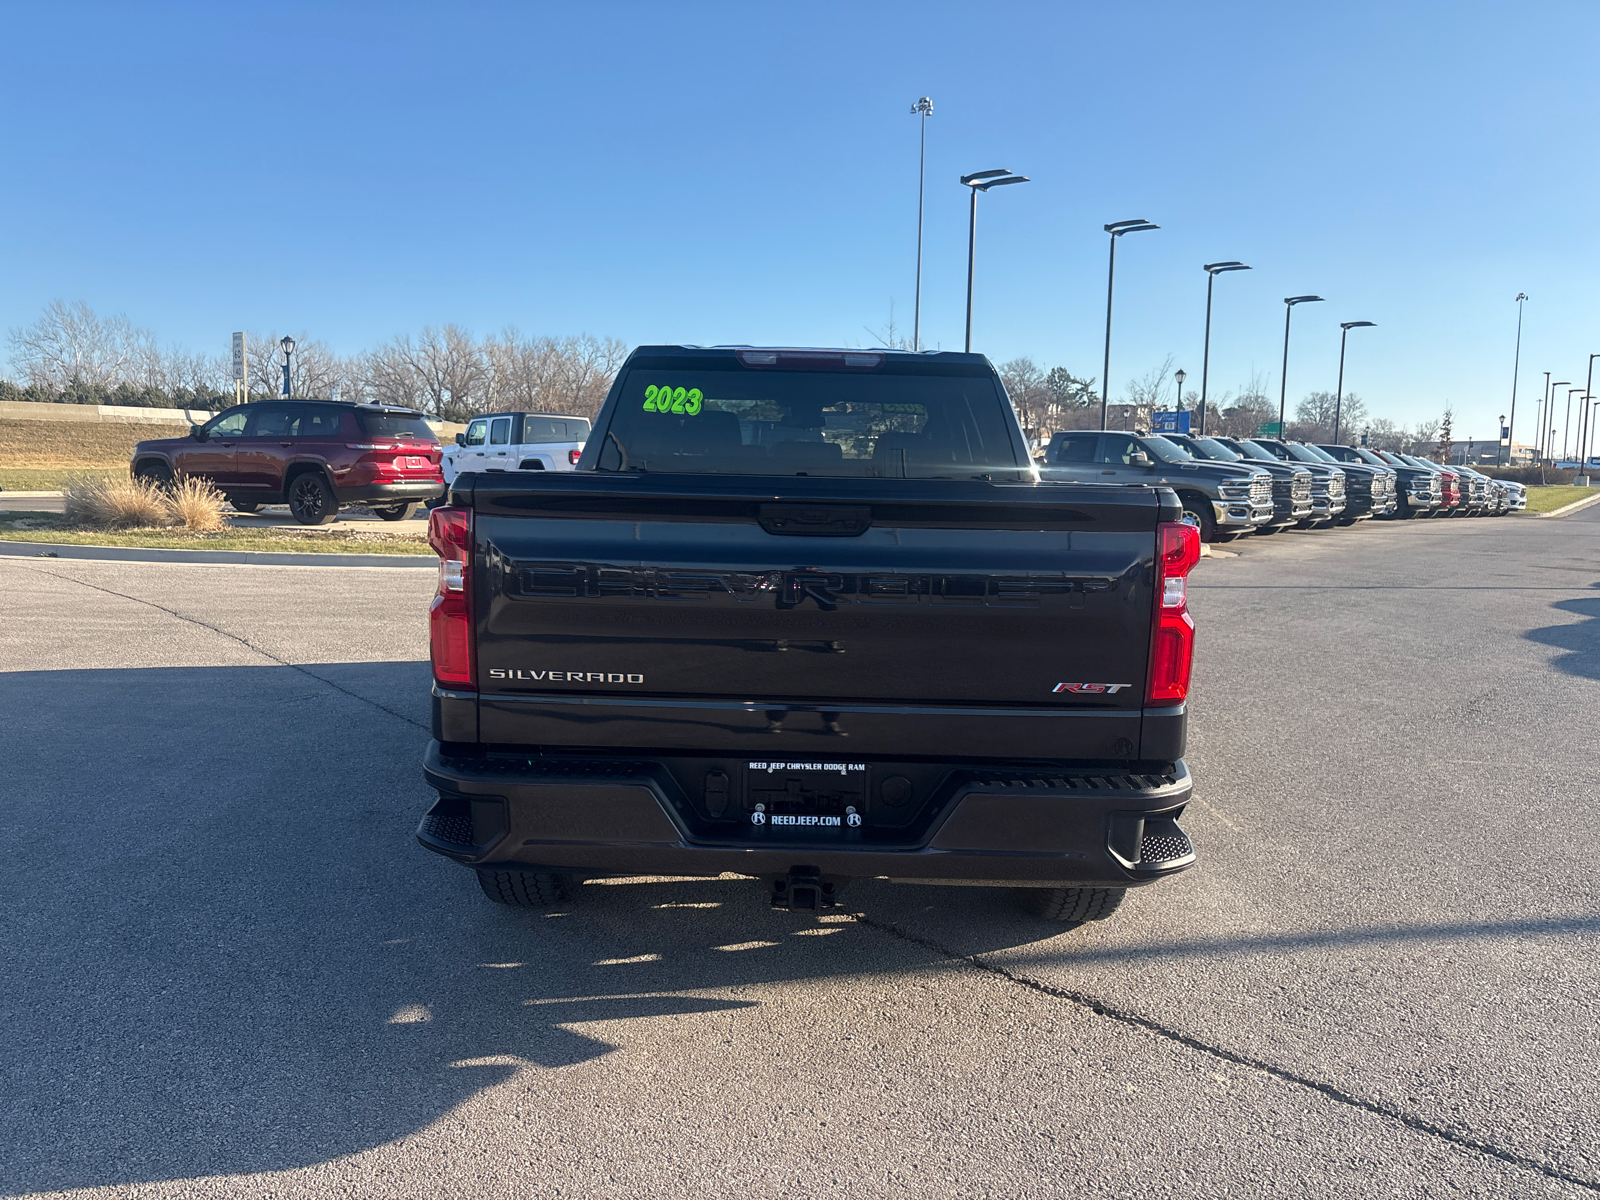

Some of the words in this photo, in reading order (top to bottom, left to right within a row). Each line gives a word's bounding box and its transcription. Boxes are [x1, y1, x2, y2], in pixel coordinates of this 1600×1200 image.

[643, 384, 703, 416] 2023
[519, 563, 1117, 610] CHEVROLET
[489, 668, 644, 684] SILVERADO
[1051, 682, 1132, 694] RST
[749, 762, 767, 770] REED
[770, 762, 785, 770] JEEP
[787, 762, 822, 771] CHRYSLER
[824, 763, 847, 771] DODGE
[848, 763, 865, 771] RAM
[771, 815, 841, 826] REEDJEEP.COM
